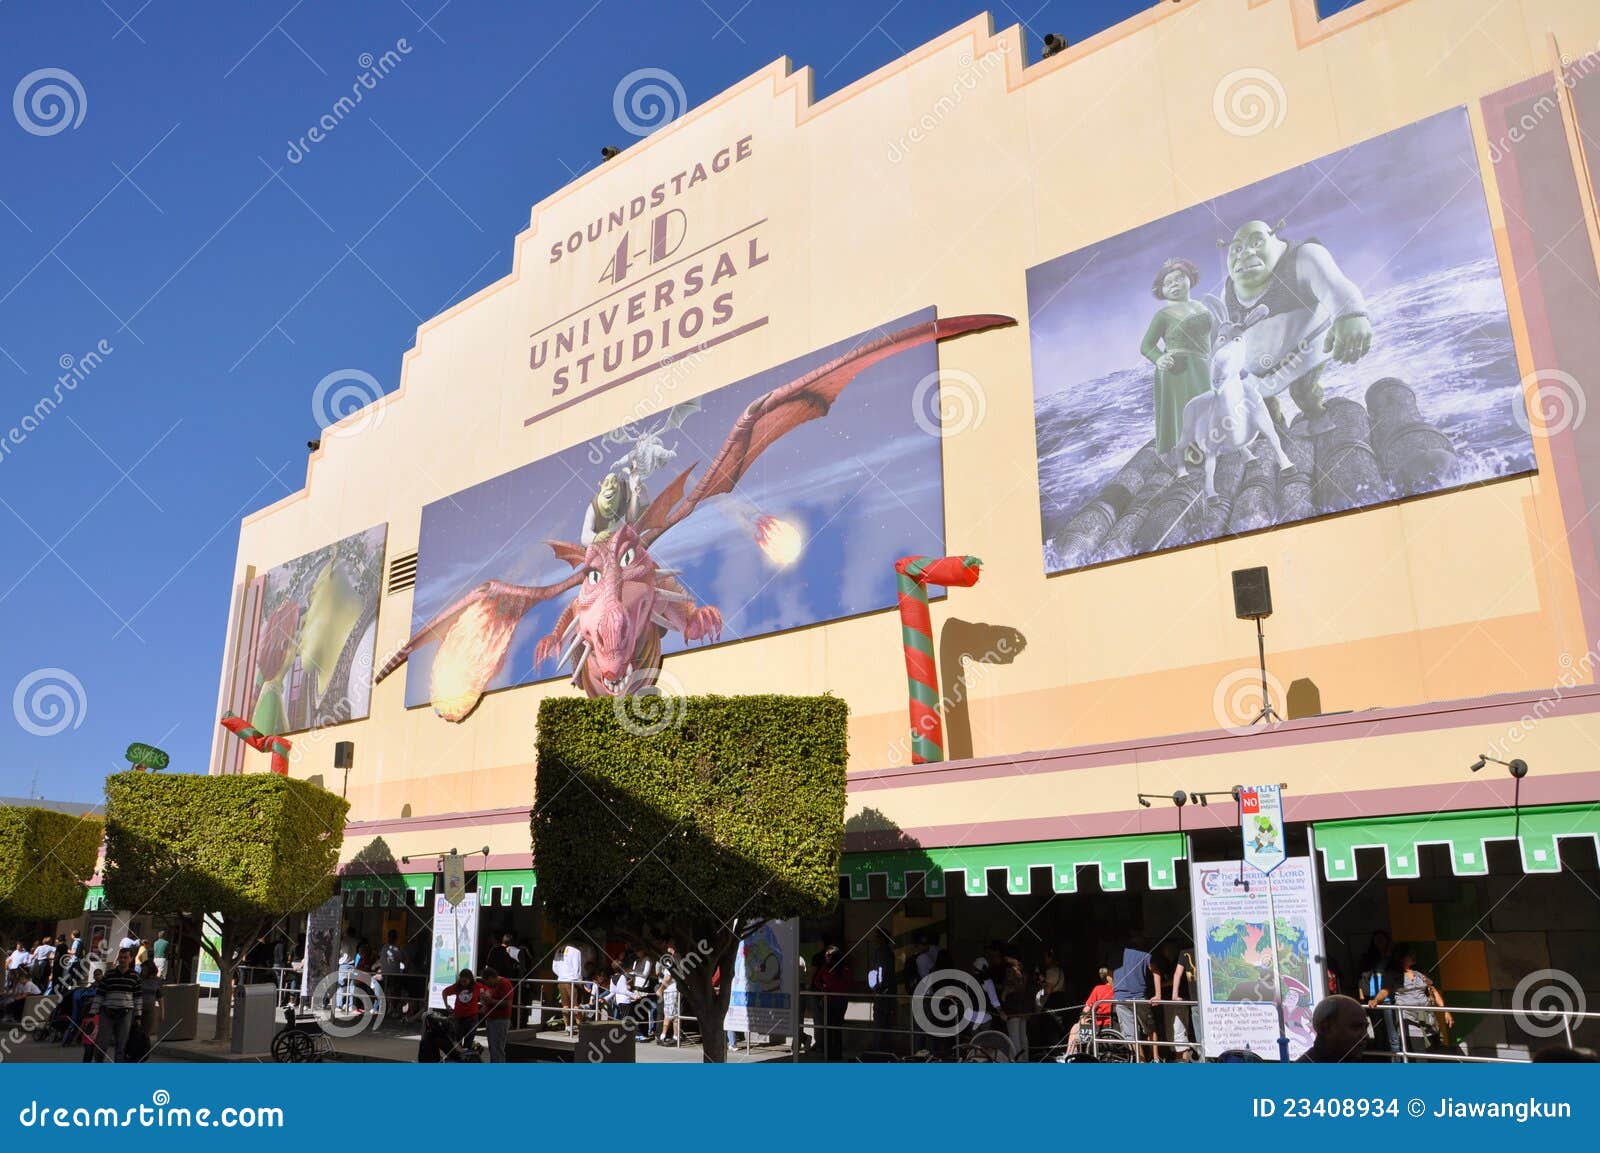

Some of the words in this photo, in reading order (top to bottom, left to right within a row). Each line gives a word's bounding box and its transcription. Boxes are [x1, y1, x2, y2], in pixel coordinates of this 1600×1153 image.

[550, 134, 753, 264] SOUNDSTAGE
[598, 208, 687, 285] 4-D
[529, 237, 769, 370] UNIVERSAL
[552, 291, 734, 397] STUDIOS
[1243, 797, 1258, 808] NO
